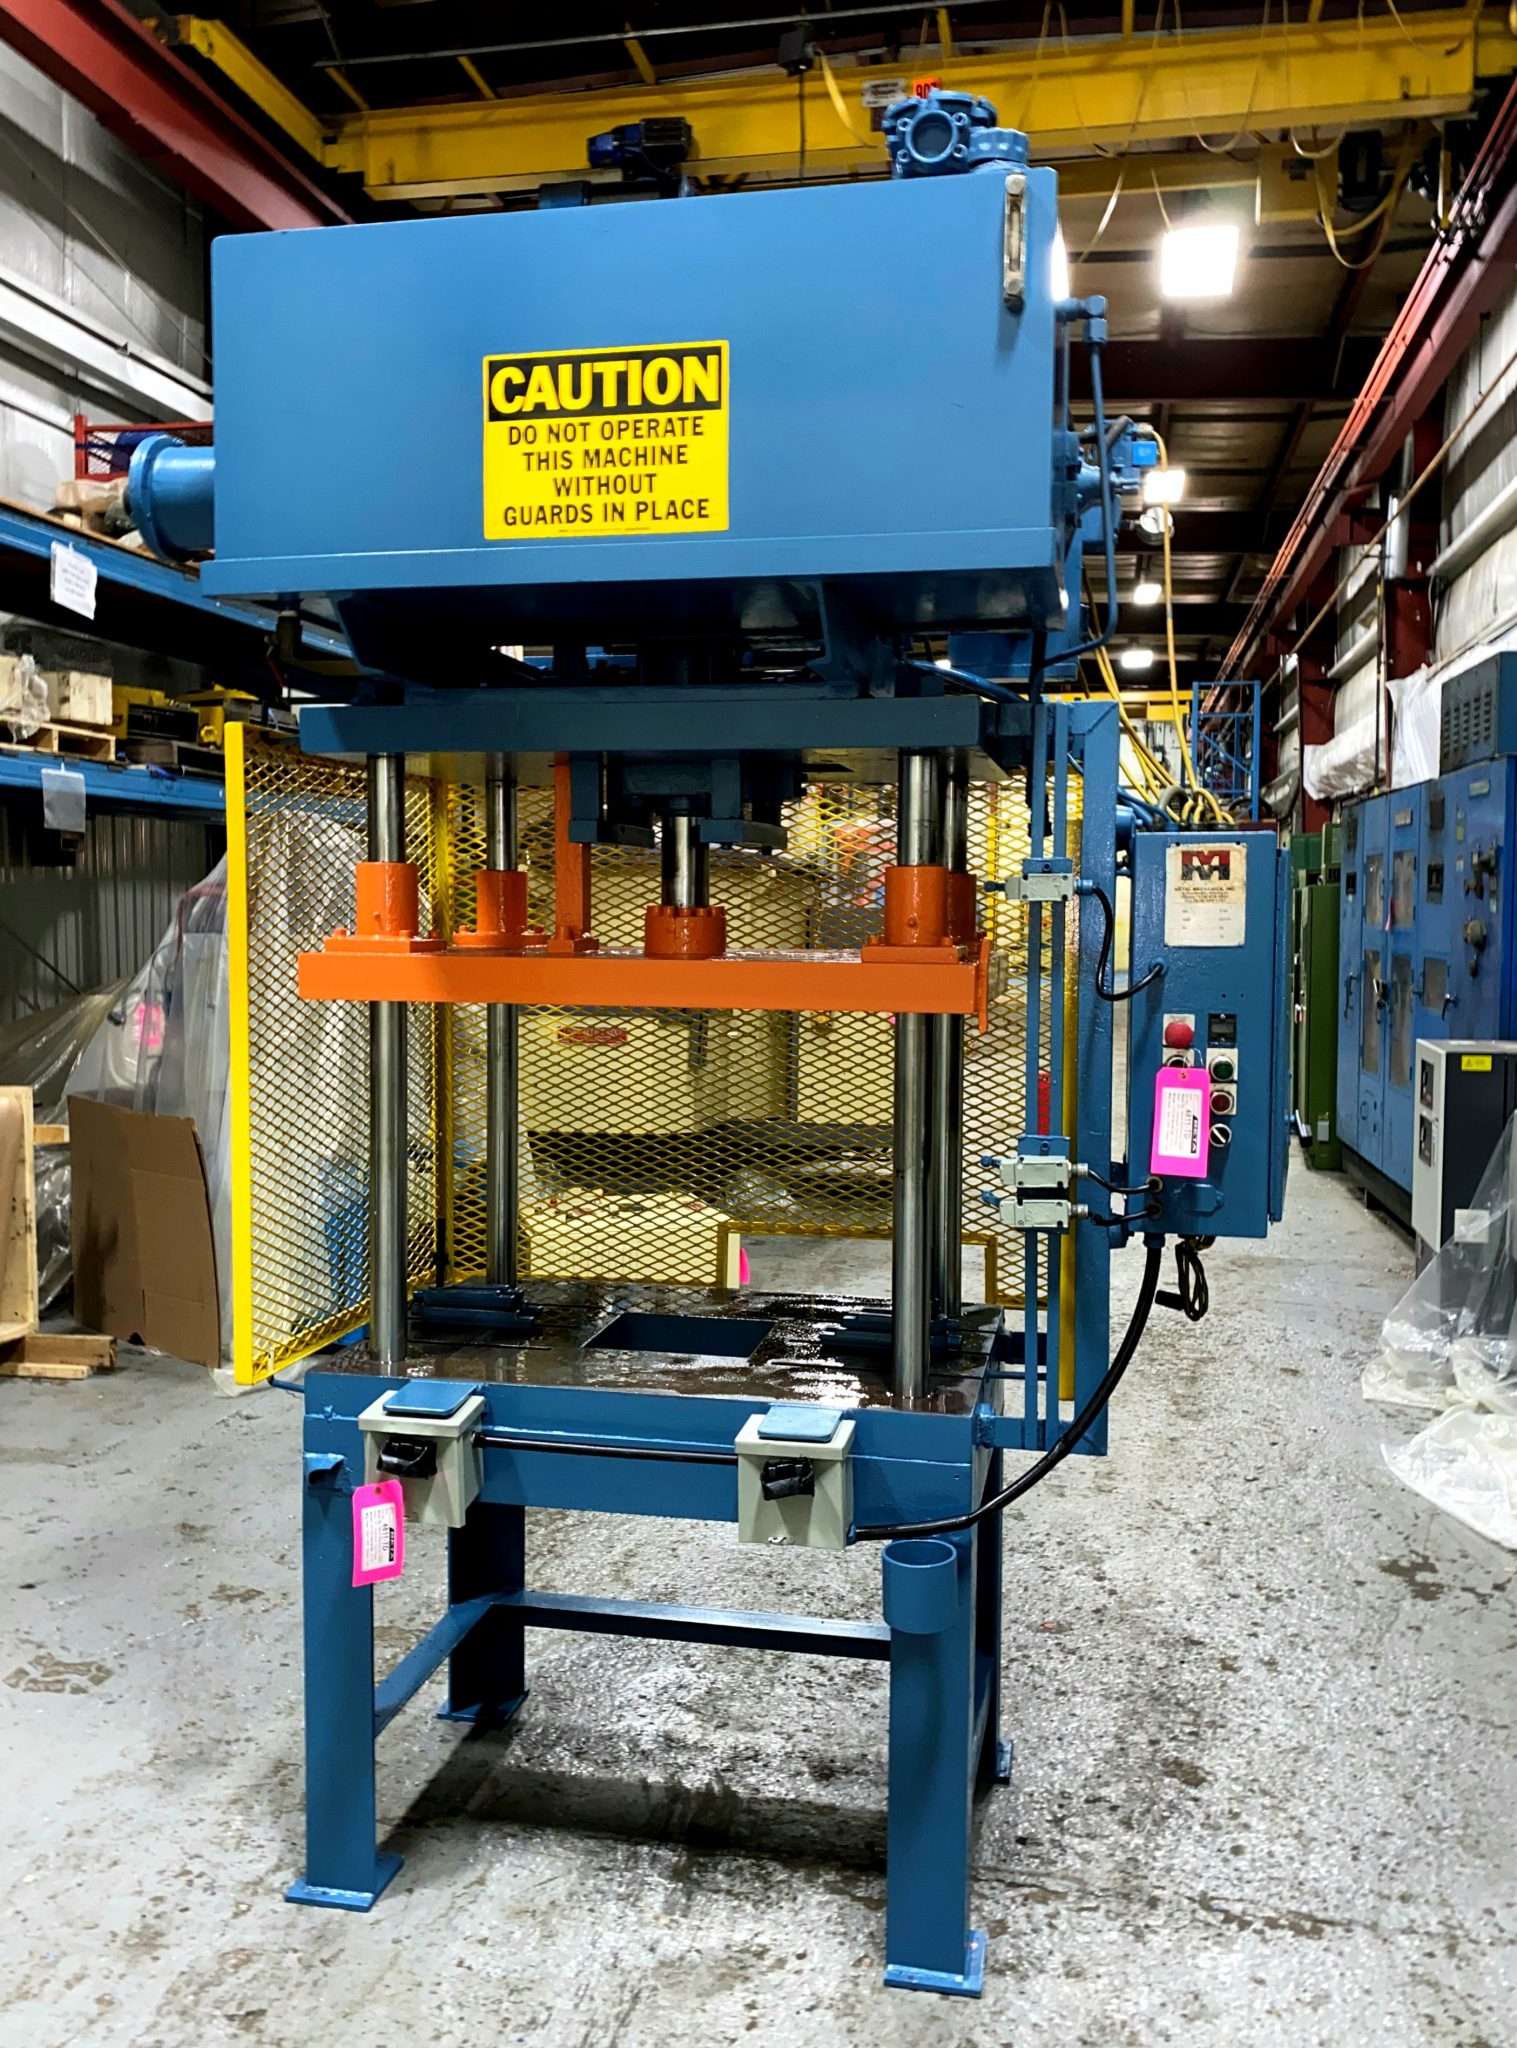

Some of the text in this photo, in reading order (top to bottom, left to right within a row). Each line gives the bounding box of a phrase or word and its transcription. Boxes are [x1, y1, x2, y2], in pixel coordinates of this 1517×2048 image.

[916, 82, 937, 98] 90
[491, 354, 719, 413] CAUTION
[509, 416, 703, 445] DO NOT OPERATE
[523, 444, 687, 471] THIS MACHINE
[554, 473, 656, 496] WITHOUT
[504, 499, 709, 526] GUARDS IN PLACE
